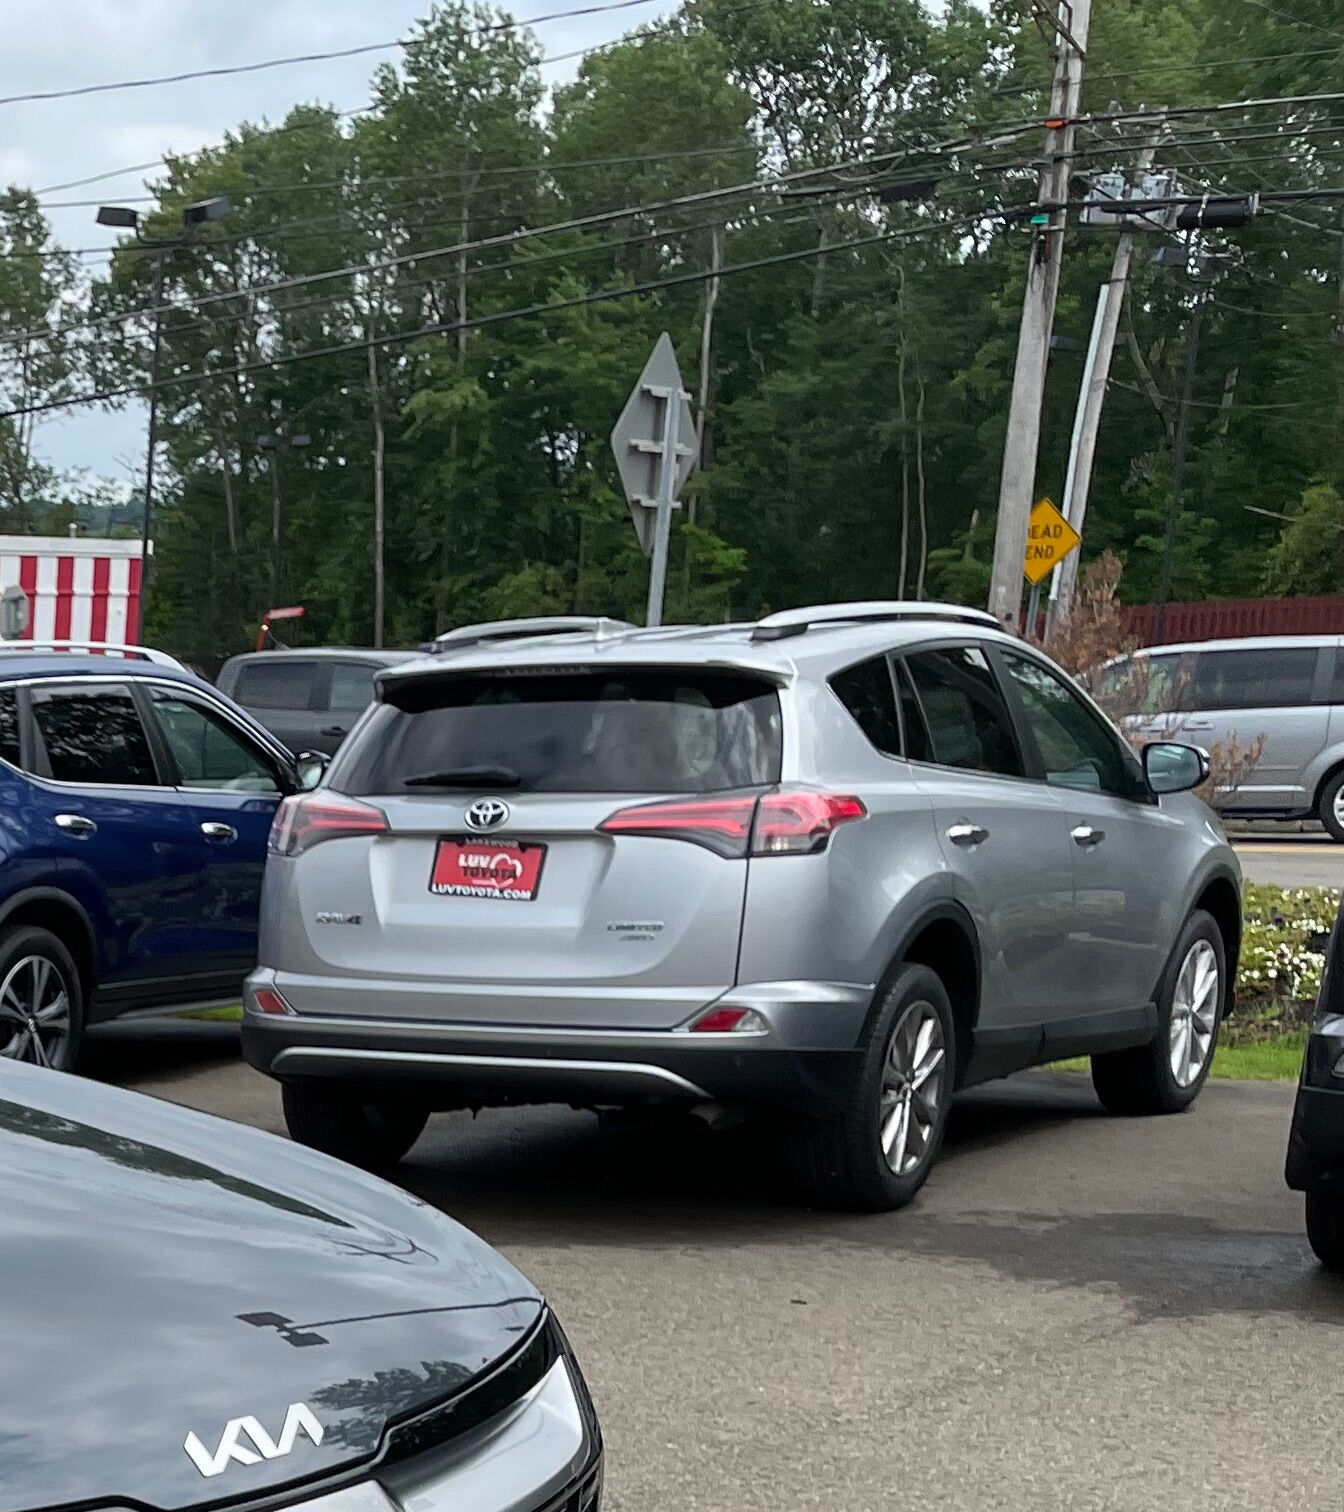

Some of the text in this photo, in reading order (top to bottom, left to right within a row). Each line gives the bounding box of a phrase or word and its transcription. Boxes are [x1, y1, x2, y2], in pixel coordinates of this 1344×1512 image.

[1024, 545, 1055, 561] END
[458, 853, 491, 869] LUV
[462, 866, 518, 880] TOYOTA
[432, 883, 532, 900] LUVTOYOTA.COM
[183, 1402, 324, 1478] KIA
